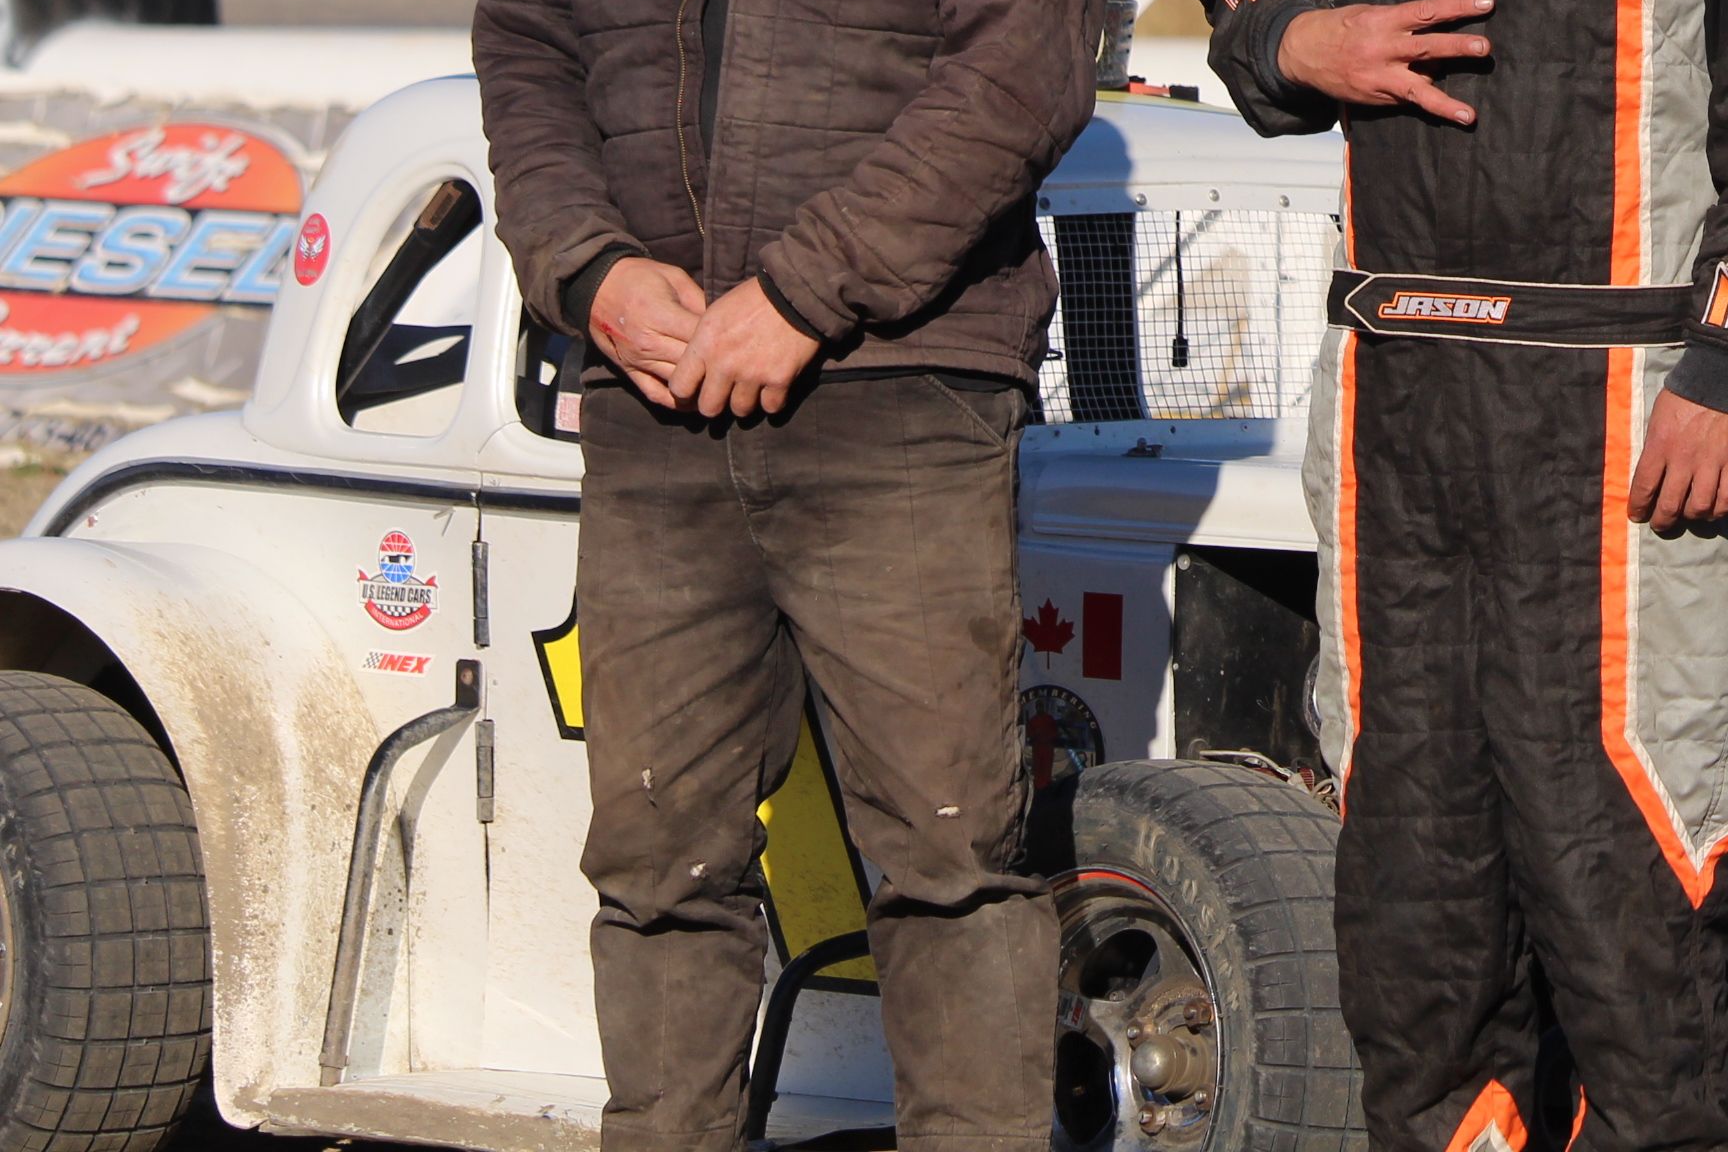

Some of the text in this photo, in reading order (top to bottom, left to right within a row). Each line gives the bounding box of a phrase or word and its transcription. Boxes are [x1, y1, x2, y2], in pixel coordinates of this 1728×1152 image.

[0, 196, 298, 303] IESEL
[1380, 294, 1509, 322] JASON
[376, 585, 406, 603] LEGEND
[407, 587, 432, 604] CARS
[371, 607, 424, 627] INTERNATIONAL
[378, 655, 430, 673] INEX
